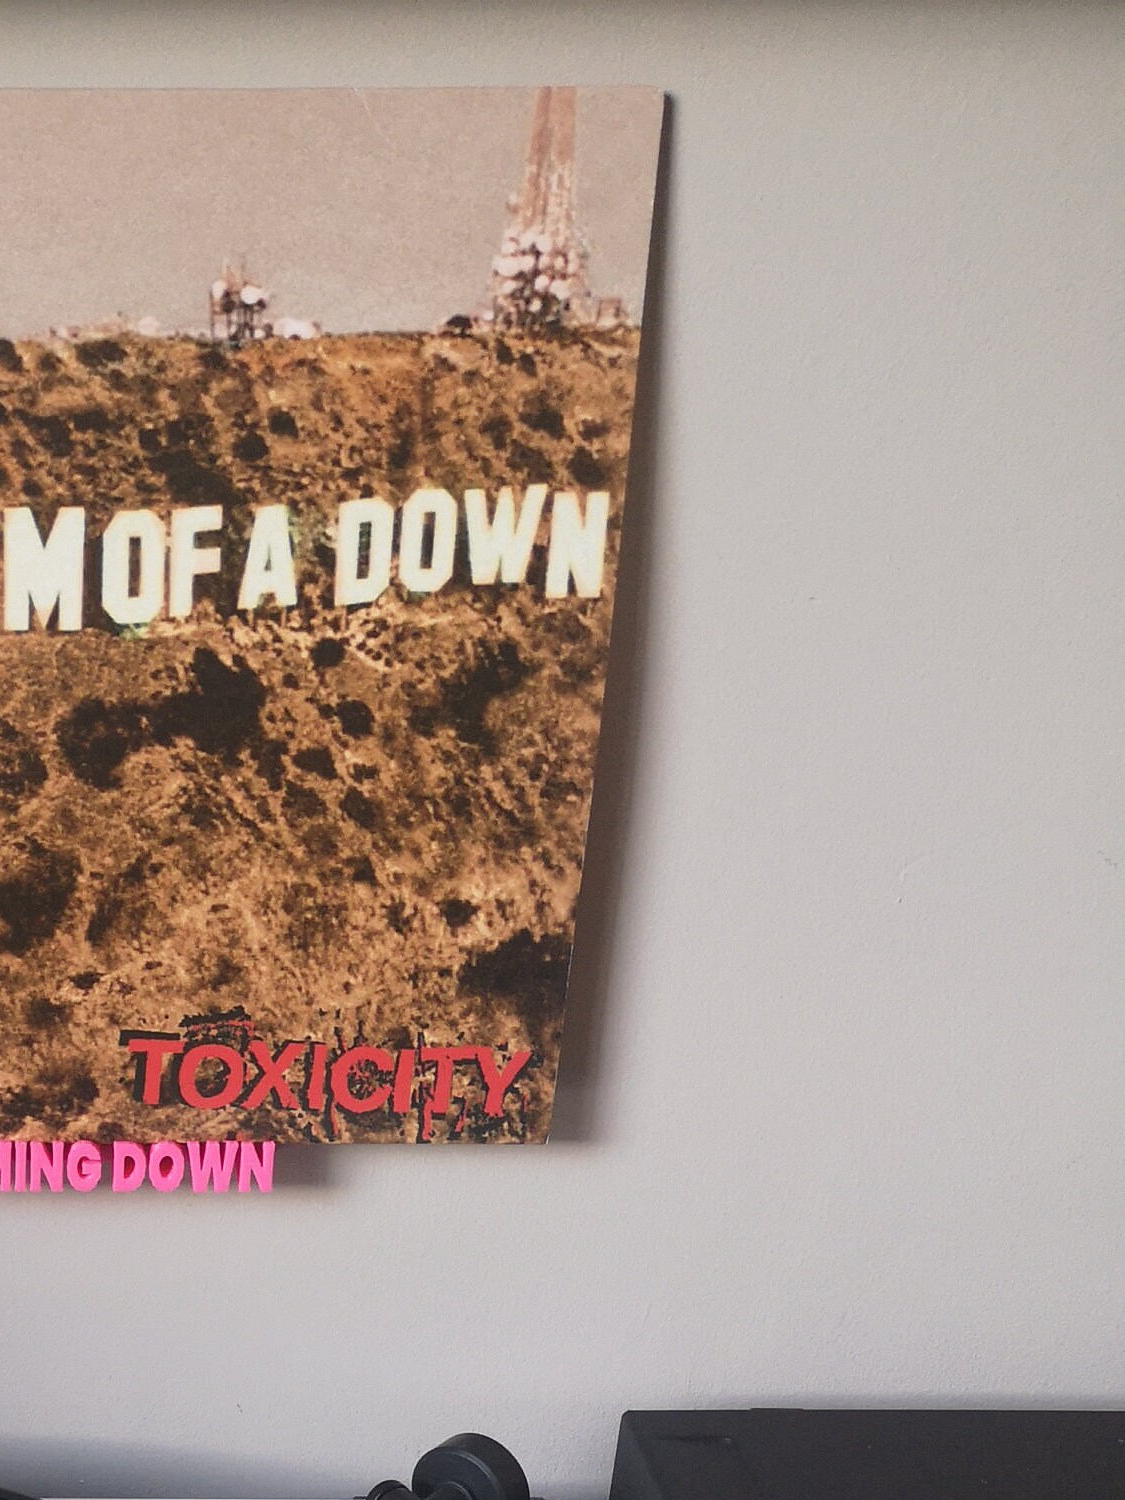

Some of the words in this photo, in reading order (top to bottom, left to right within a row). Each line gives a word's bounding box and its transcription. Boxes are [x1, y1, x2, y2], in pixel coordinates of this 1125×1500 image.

[102, 504, 223, 624] OF
[239, 505, 297, 608] A
[332, 484, 610, 607] DOWN
[129, 1037, 532, 1118] TOXICITY
[113, 1142, 274, 1193] DOWN
